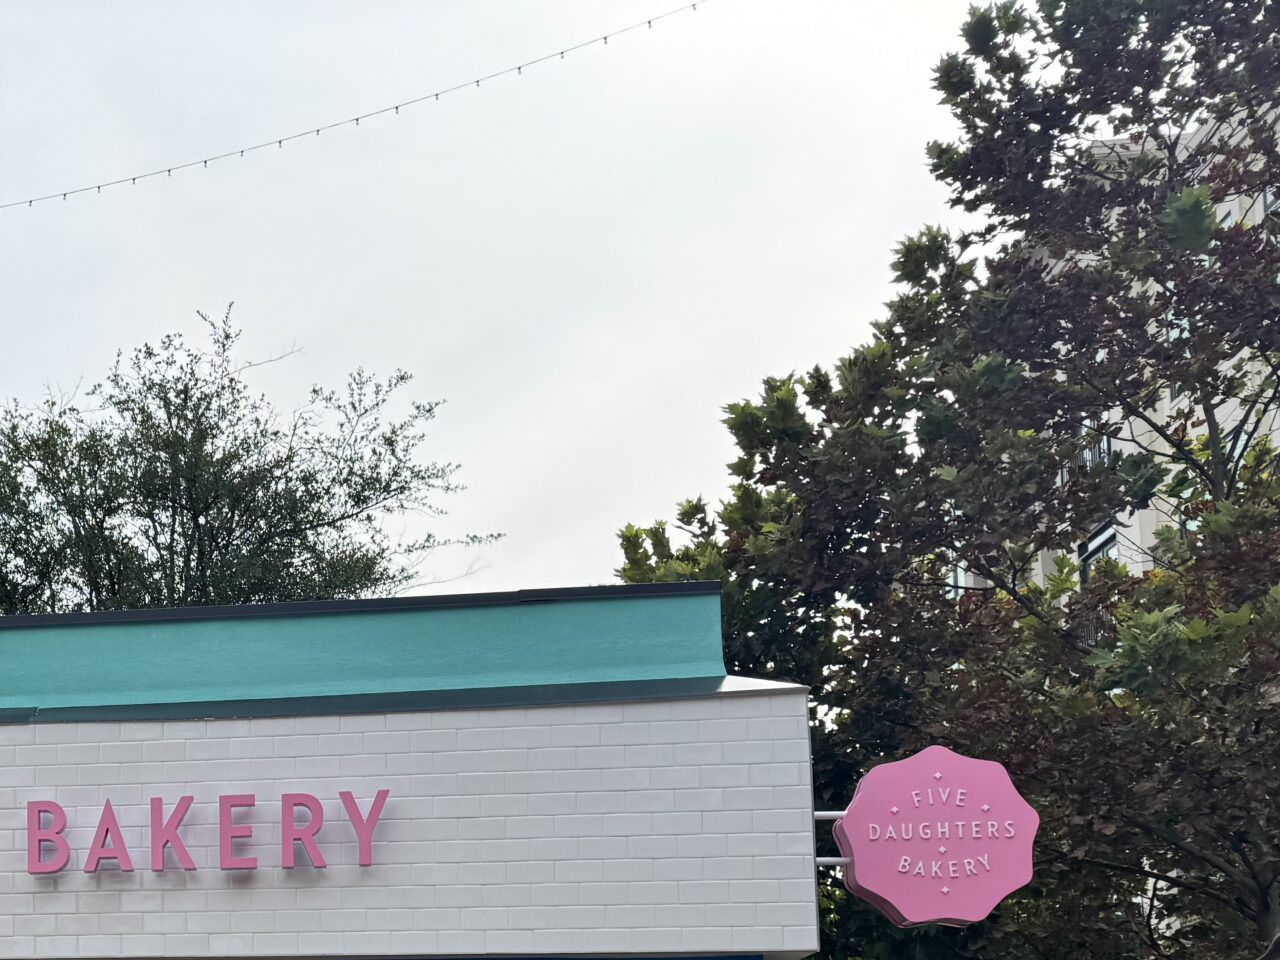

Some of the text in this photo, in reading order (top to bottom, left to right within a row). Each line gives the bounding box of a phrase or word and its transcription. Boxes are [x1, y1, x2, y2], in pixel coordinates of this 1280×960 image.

[911, 787, 968, 808] FIVE
[26, 789, 390, 875] BAKERY
[869, 820, 1016, 842] DAUGHTERS
[897, 853, 991, 878] BAKERY
